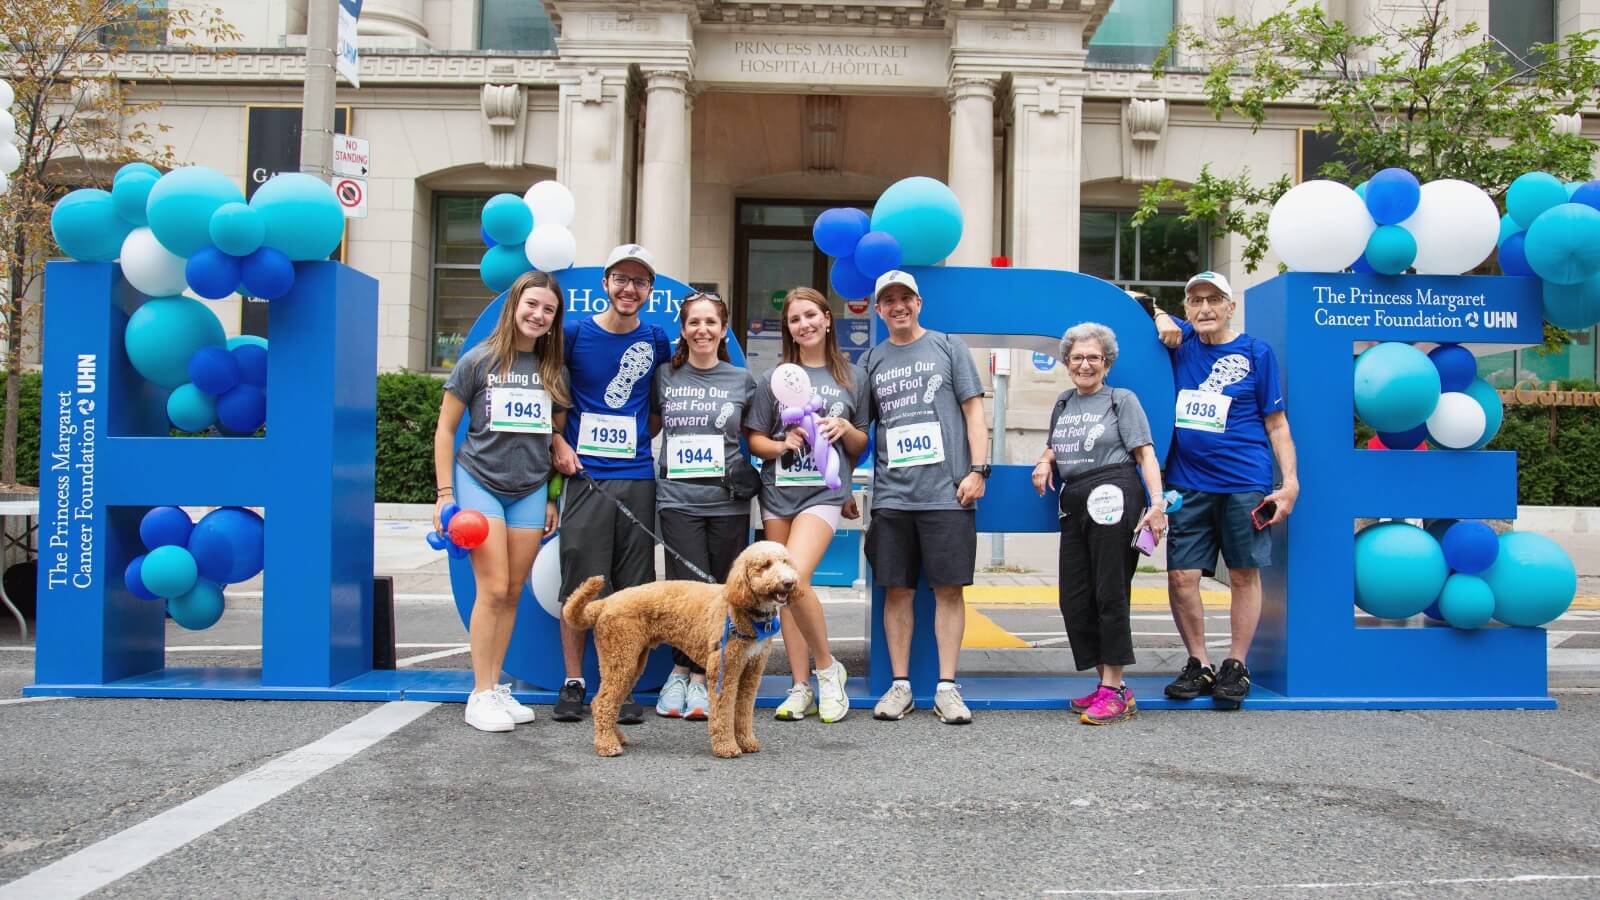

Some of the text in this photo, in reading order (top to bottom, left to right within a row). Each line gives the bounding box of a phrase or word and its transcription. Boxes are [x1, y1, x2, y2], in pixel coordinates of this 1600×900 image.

[735, 41, 911, 58] PRINCESS MARGARET
[345, 140, 358, 151] NO
[335, 150, 368, 165] STANDING
[1313, 286, 1486, 312] The Princess Margaret
[1314, 308, 1518, 328] Cancer Foundation UHN
[875, 361, 936, 385] Putting Our
[664, 385, 730, 399] Putting Our
[821, 384, 842, 398] Our
[876, 376, 923, 399] Best Foot
[504, 401, 542, 419] 1943
[665, 399, 718, 413] Best Foot
[1185, 401, 1217, 418] 1938
[664, 414, 710, 428] Forward
[1082, 412, 1103, 423] Our
[592, 426, 628, 444] 1939
[1068, 425, 1087, 438] Foot
[896, 435, 932, 454] 1940
[676, 447, 713, 464] 1944
[73, 354, 97, 589] Cancer Foundation UHN
[48, 390, 78, 590] The Princess Margaret
